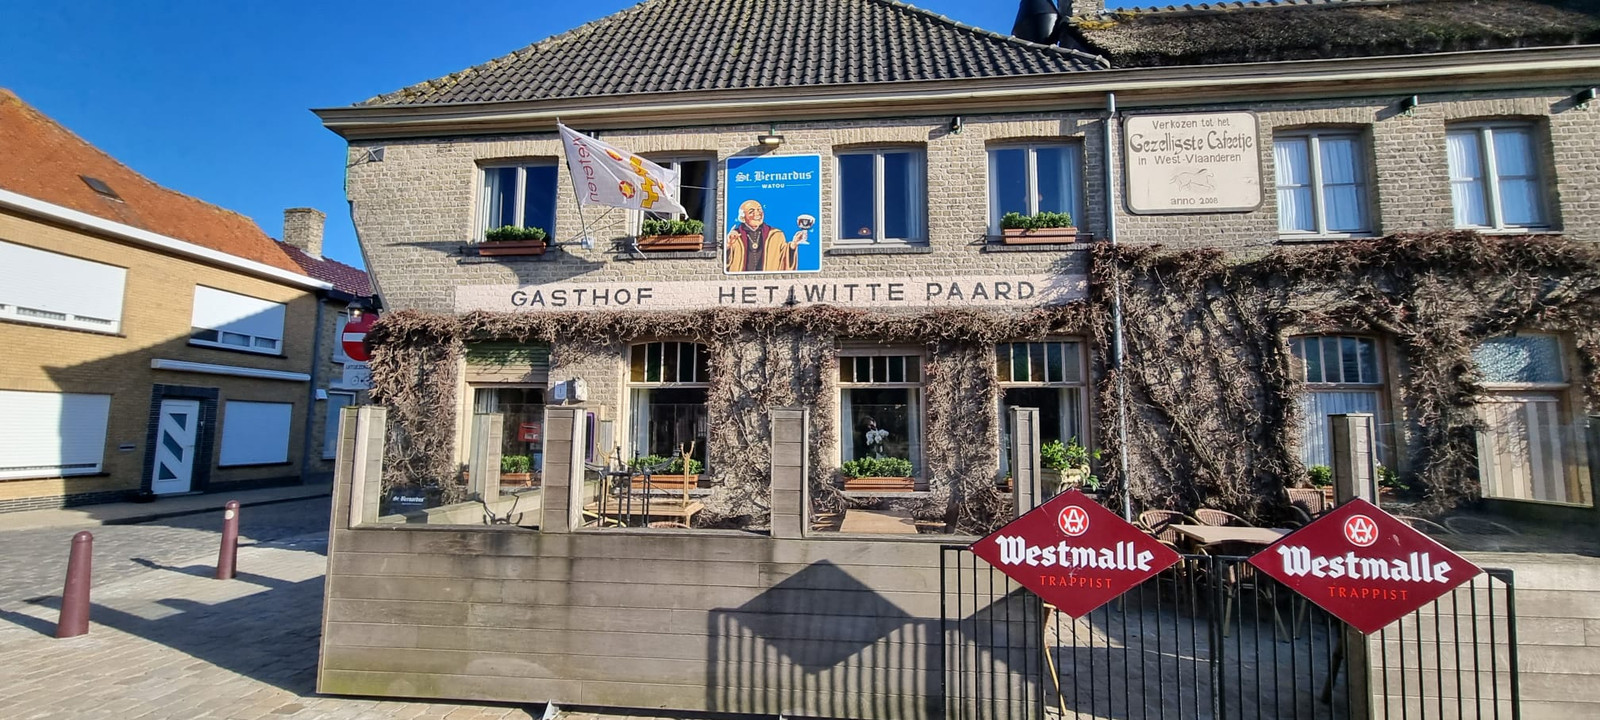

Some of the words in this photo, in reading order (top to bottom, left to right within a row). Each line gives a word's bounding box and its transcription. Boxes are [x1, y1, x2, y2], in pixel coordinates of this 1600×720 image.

[1152, 120, 1197, 130] Verkozen
[1201, 119, 1214, 128] tot
[1217, 118, 1230, 127] het
[1129, 132, 1204, 155] Gezelligste
[1207, 130, 1253, 152] Cafeetje
[1138, 156, 1147, 165] in
[735, 171, 752, 183] St.
[753, 170, 814, 183] Bernardus
[1170, 197, 1196, 205] anno
[1199, 197, 1219, 205] 2008
[511, 287, 653, 307] GASTHOF
[718, 285, 779, 305] HET
[804, 283, 905, 302] WITTE
[926, 281, 1035, 301] PAARD
[995, 534, 1154, 572] Westmalle
[1276, 544, 1453, 584] Westmalle
[1040, 575, 1112, 589] TRAPPIST
[1328, 586, 1408, 600] TRAPPIST
